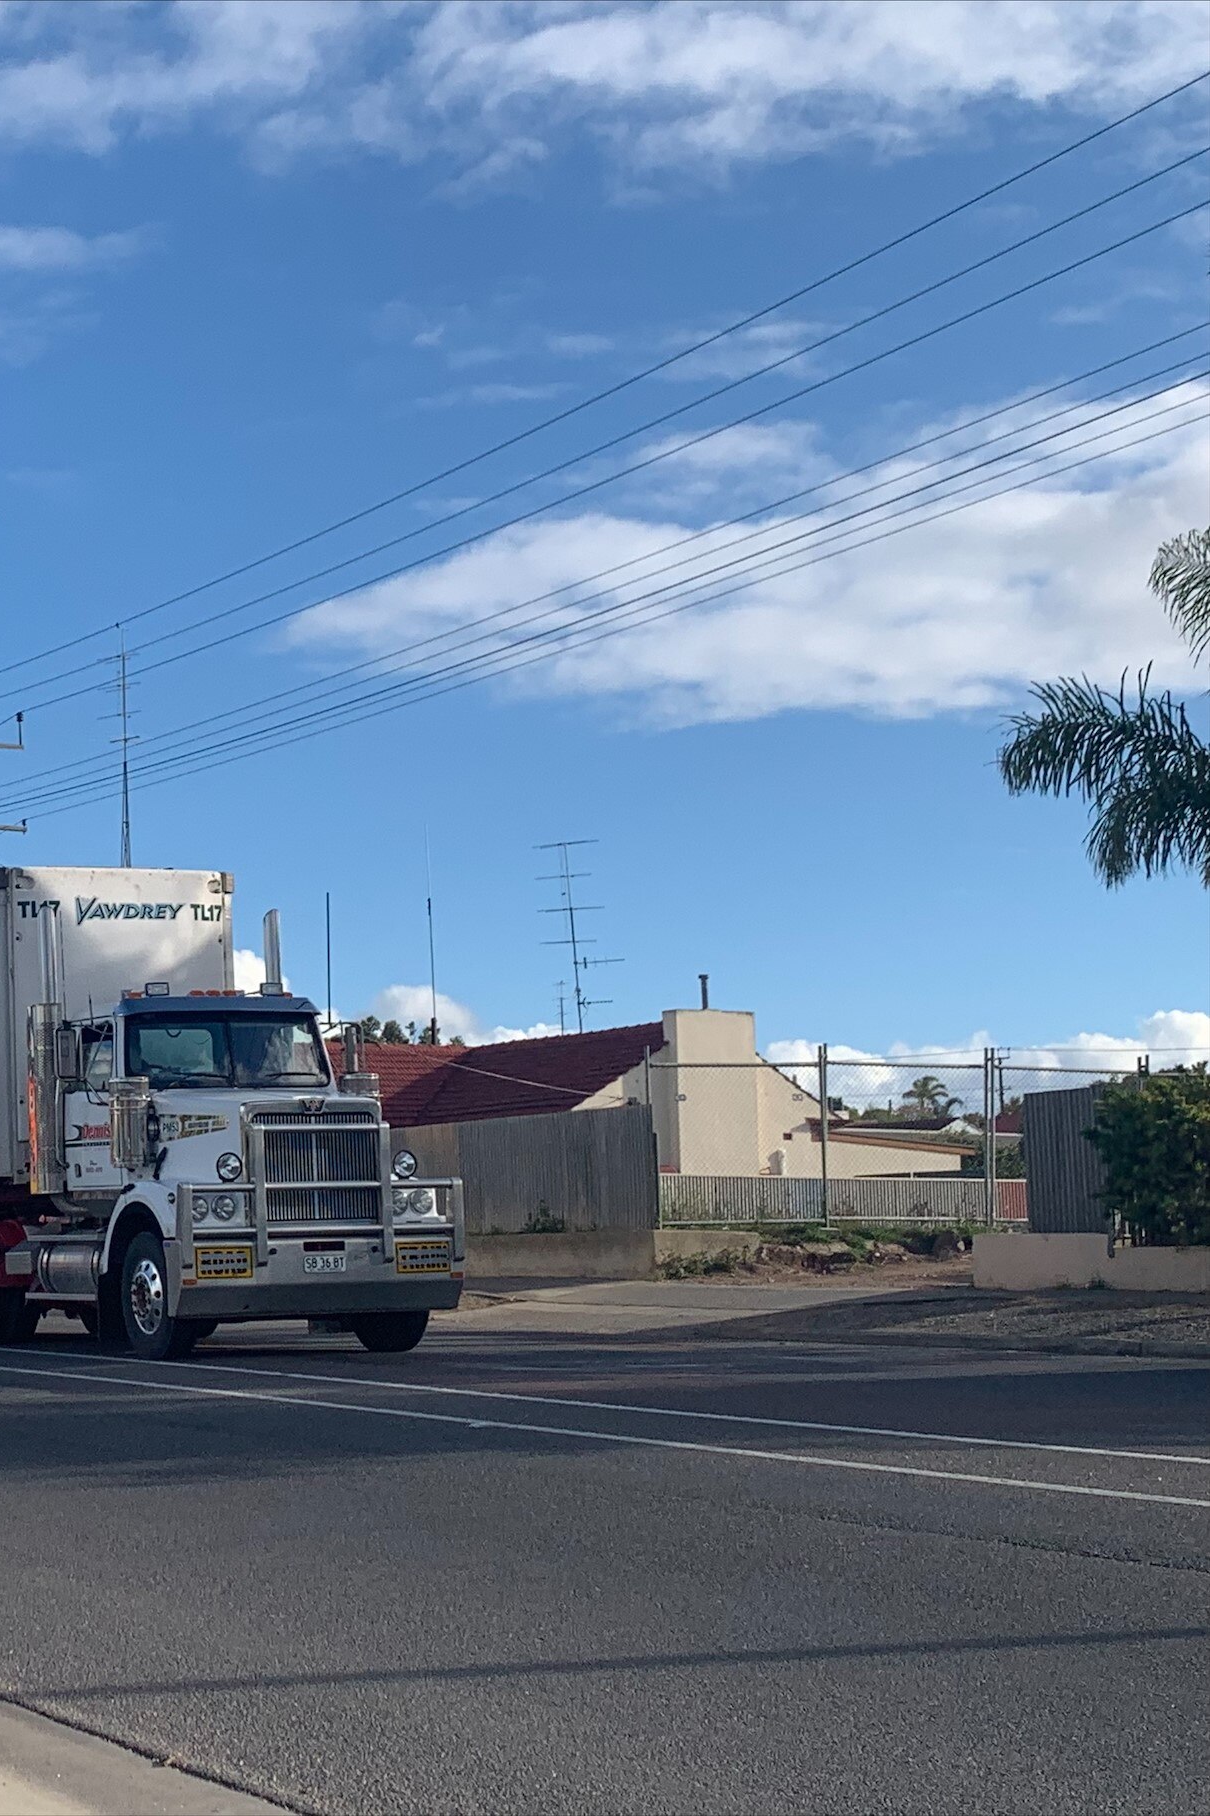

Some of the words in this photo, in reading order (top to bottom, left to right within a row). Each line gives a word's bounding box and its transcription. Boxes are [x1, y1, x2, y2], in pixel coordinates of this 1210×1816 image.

[17, 901, 60, 918] TL7
[75, 895, 185, 925] VAWDREY
[191, 904, 222, 921] TL17
